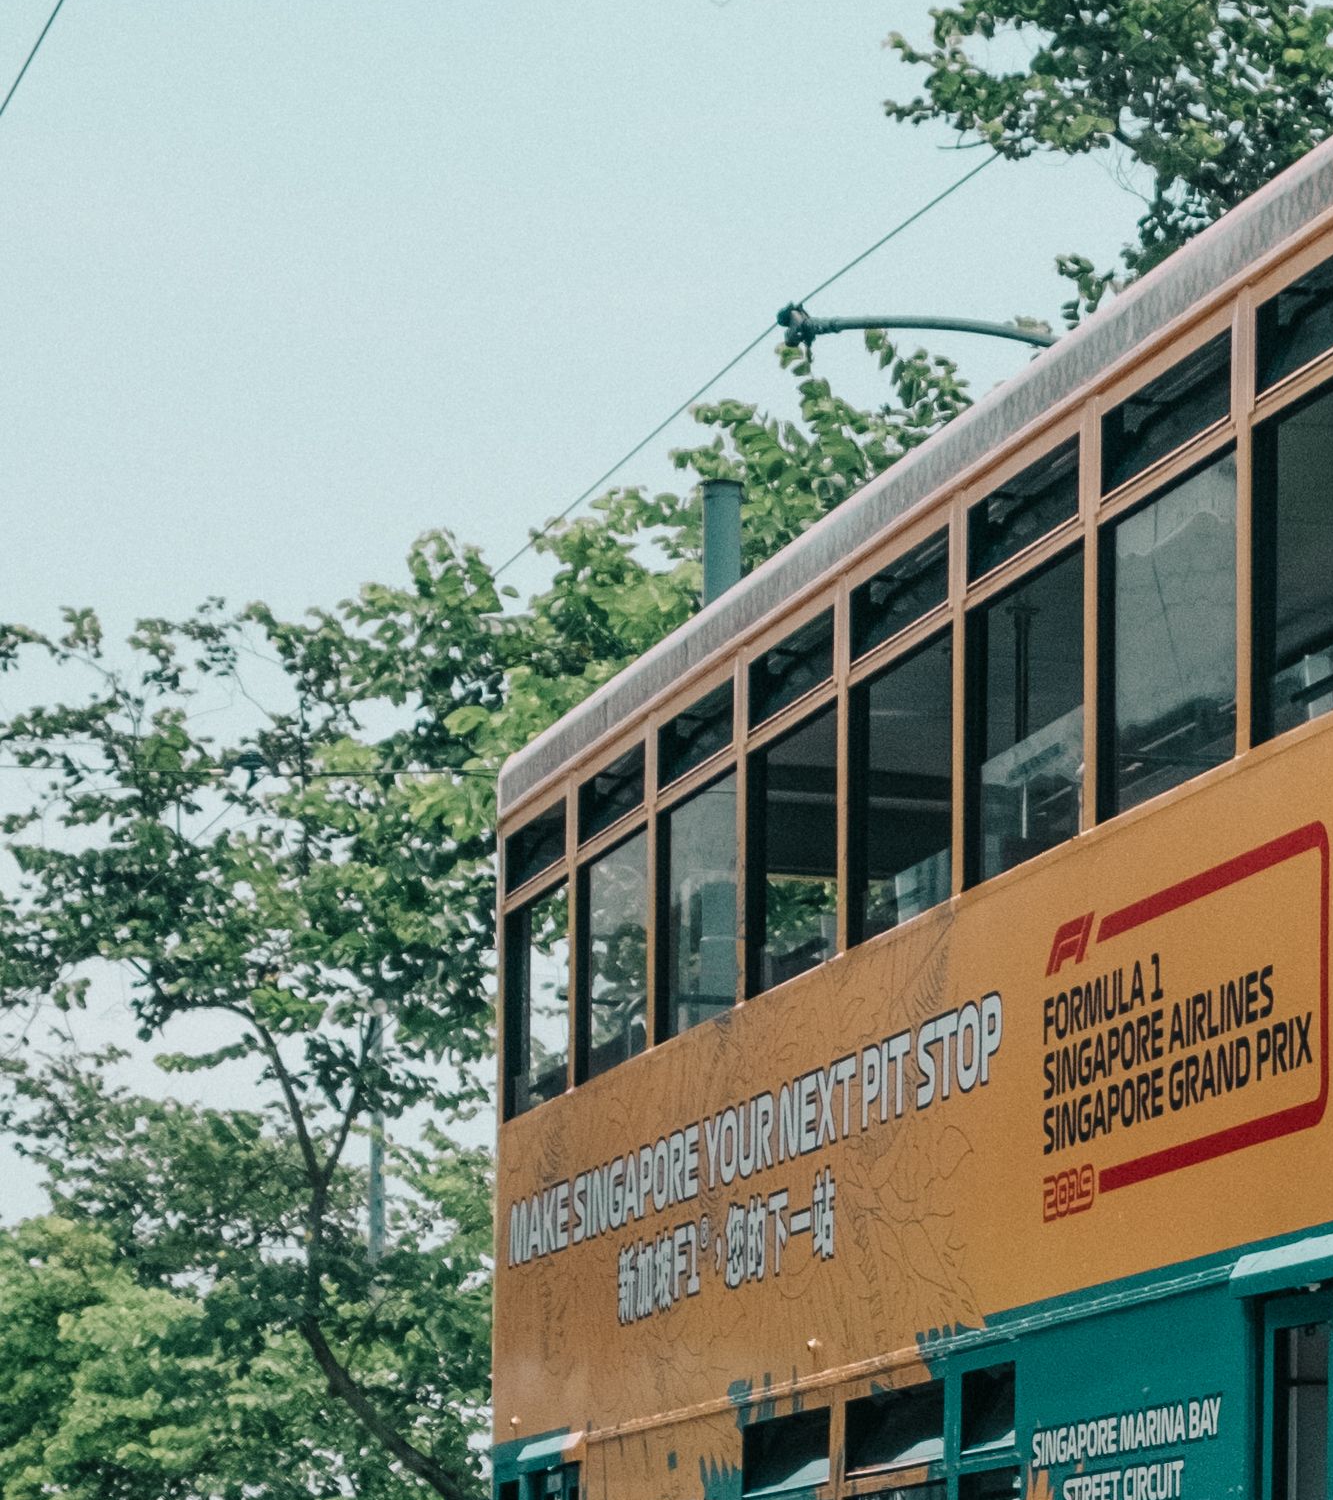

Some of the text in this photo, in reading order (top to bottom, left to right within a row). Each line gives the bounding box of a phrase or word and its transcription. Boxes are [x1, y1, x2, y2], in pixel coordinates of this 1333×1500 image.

[1043, 952, 1164, 1046] FORMULA 1
[1043, 963, 1275, 1100] SINGAPORE AIRLINES
[508, 990, 1003, 1268] MAKE SINGAPORE YOUR NEXT PIT STOP
[1043, 1011, 1313, 1155] SINGAPORE GRAND PRIX
[1043, 1163, 1095, 1223] 2019
[1031, 1393, 1222, 1468] SINGAPORE MARINA BAY
